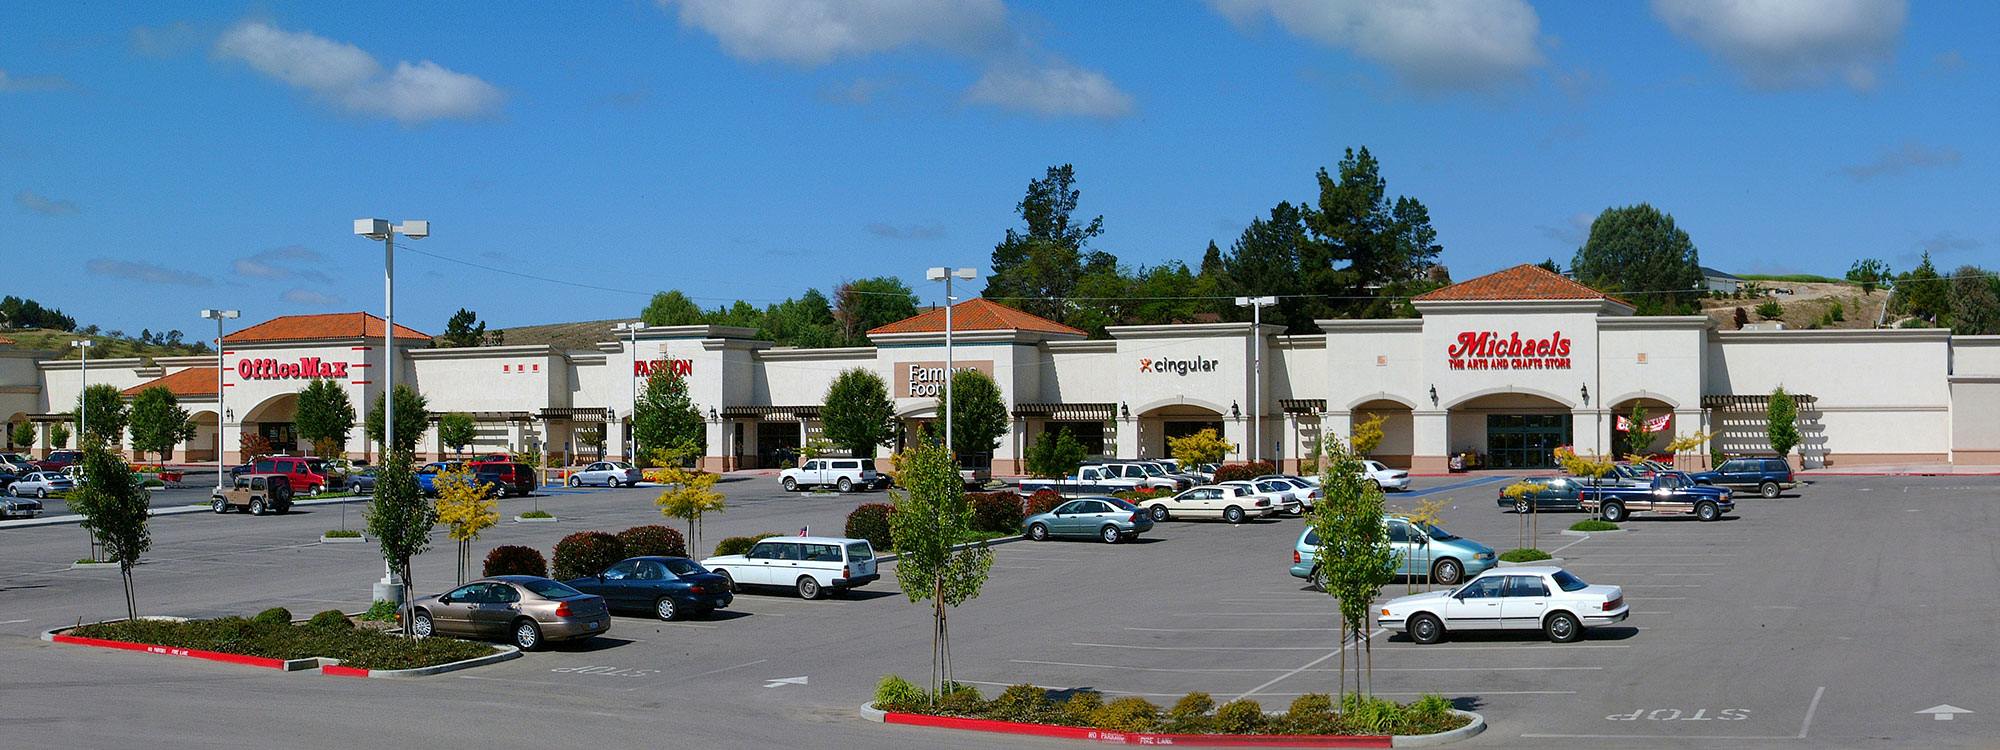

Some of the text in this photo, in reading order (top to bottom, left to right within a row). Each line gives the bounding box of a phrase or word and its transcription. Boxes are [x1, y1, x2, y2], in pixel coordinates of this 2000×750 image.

[1448, 331, 1571, 358] Michaels
[238, 357, 348, 380] OfficeMax
[1154, 355, 1219, 376] cingular
[1448, 358, 1571, 370] THE ARTS AND CRAFTS STORE
[909, 364, 977, 382] Fam
[551, 665, 660, 677] STOP
[1605, 708, 1750, 720] STOP
[1088, 731, 1097, 739] NO
